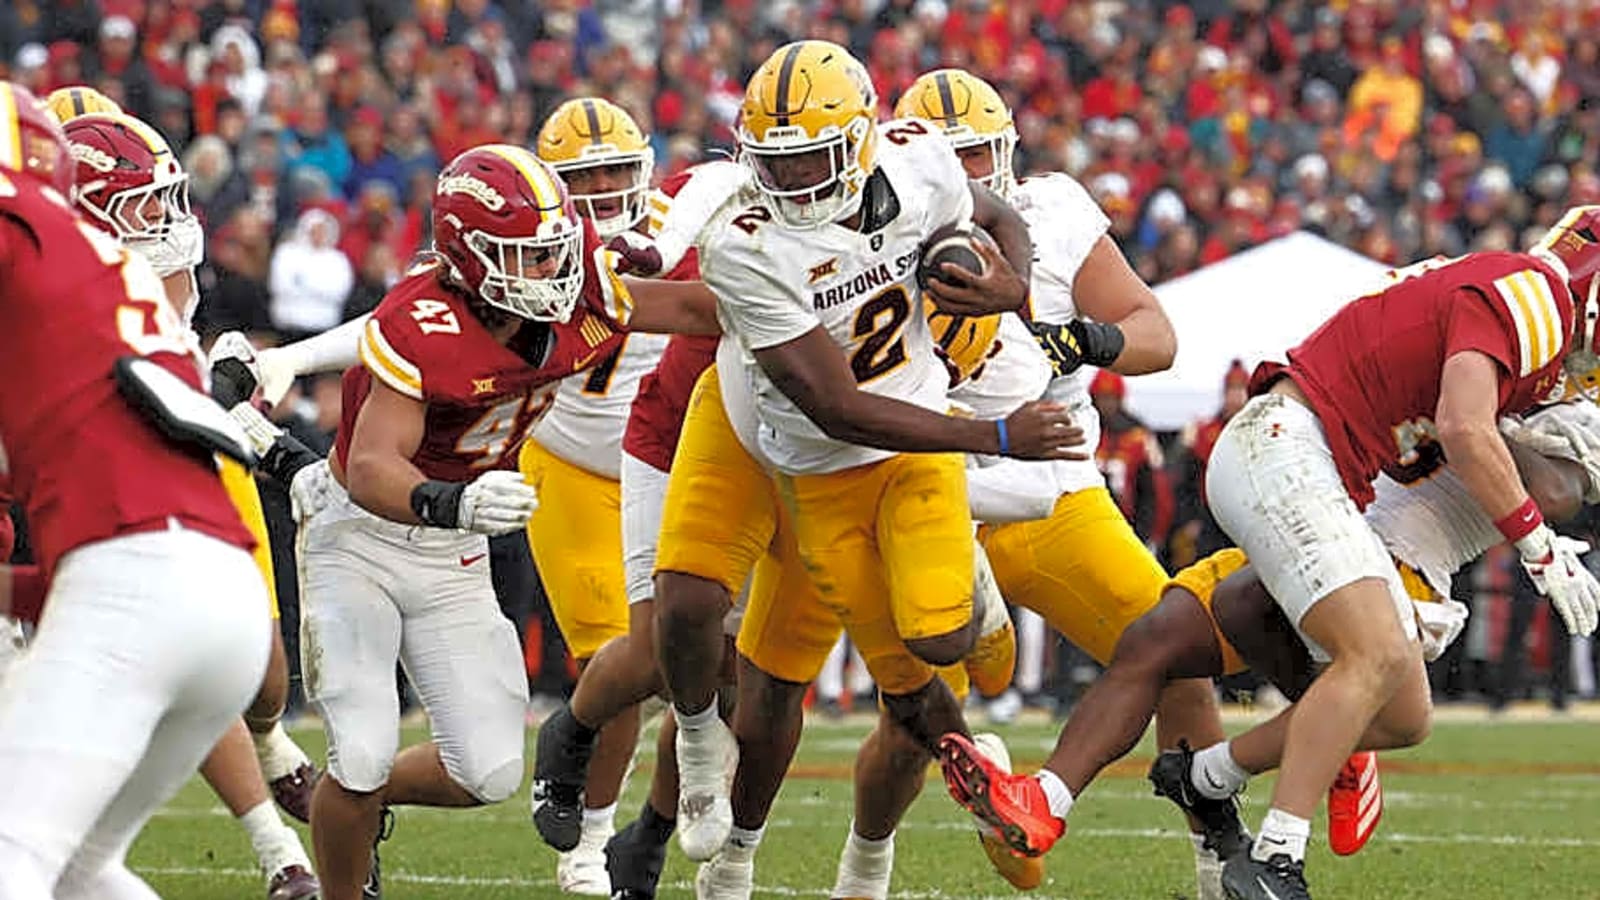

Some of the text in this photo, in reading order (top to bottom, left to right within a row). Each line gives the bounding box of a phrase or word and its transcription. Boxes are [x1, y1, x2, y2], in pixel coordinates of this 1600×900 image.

[885, 120, 929, 146] 2
[731, 204, 772, 235] 2
[813, 263, 894, 310] ARIZONA
[409, 299, 462, 335] 47
[848, 282, 913, 387] 2
